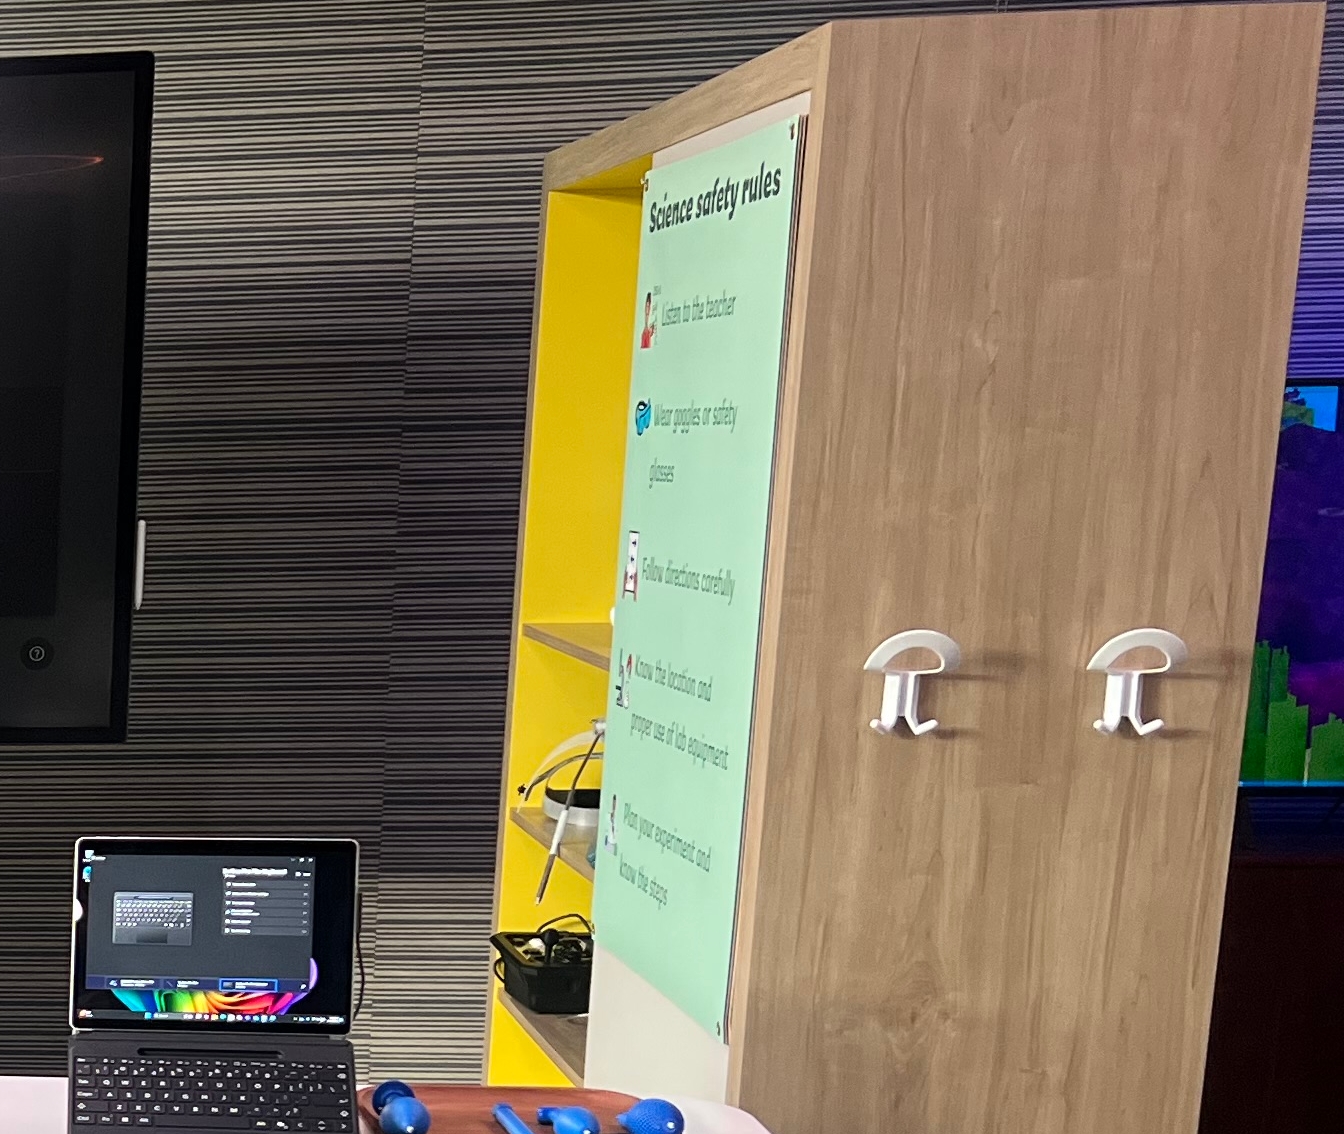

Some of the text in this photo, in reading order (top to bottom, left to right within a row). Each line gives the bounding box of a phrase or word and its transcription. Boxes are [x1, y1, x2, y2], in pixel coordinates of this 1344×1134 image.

[650, 161, 781, 232] Science safety rules
[662, 289, 736, 326] Listen to the teacher
[654, 398, 738, 433] Wear goggles or safety
[649, 457, 674, 489] glasses
[642, 557, 735, 606] Follow directions carefully
[635, 654, 713, 702] Know the location and
[630, 713, 728, 770] proper use of lab equipment
[623, 803, 712, 872] Plan your experiment and
[620, 852, 668, 910] know the steps
